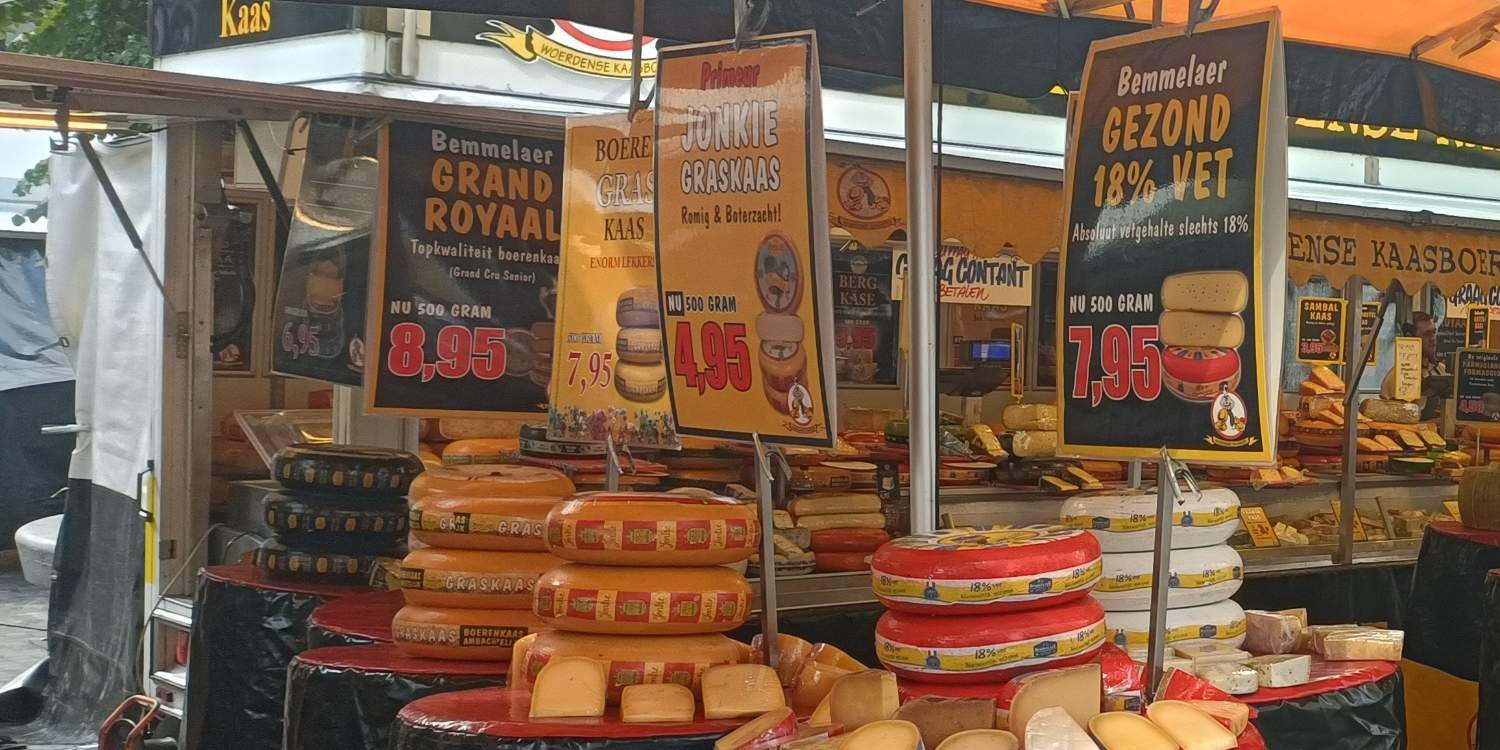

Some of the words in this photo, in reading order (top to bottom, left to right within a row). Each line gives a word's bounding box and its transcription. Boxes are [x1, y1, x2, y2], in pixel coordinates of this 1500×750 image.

[219, 0, 271, 37] Kaas
[541, 44, 610, 73] WOERDENSE
[701, 60, 760, 91] Primeur
[1117, 53, 1227, 97] Bemmelaer
[681, 99, 779, 152] JONKIE
[1102, 93, 1231, 153] GEZOND
[431, 129, 553, 165] Bemmelaer
[432, 158, 552, 203] GRAND
[681, 155, 781, 195] GRASKAAS
[1093, 159, 1156, 209] 18%
[1172, 148, 1233, 201] VET
[425, 197, 561, 241] ROYAAL
[604, 217, 644, 240] KAAS
[682, 206, 709, 229] Romig
[714, 206, 722, 223] &
[725, 203, 781, 224] Boterzacht!
[1072, 223, 1117, 242] Absoluut
[1119, 217, 1174, 243] vetgehalte
[1178, 216, 1218, 236] slechts
[1223, 214, 1249, 234] 18%
[410, 239, 492, 260] Topkwaliteit
[590, 257, 620, 269] ENORM
[449, 266, 480, 279] (Grand
[484, 268, 500, 280] Cru
[839, 275, 877, 290] BERG
[956, 257, 1029, 289] CONTANT
[390, 300, 411, 315] NU
[417, 302, 444, 316] 500
[451, 304, 492, 319] GRAM
[668, 294, 682, 312] NU
[686, 296, 704, 312] 500
[708, 295, 736, 312] GRAM
[1069, 294, 1085, 313] NU
[1090, 295, 1113, 313] 500
[1118, 293, 1153, 312] GRAM
[1304, 302, 1339, 312] SAMBAL
[1310, 312, 1333, 321] KAAS
[388, 322, 506, 382] 8,95
[674, 320, 752, 396] 4,95
[1068, 323, 1162, 408] 7,95
[569, 351, 612, 394] 7,95
[1130, 513, 1147, 523] 18%
[446, 575, 535, 592] GRASKAAS
[970, 581, 991, 593] 18%
[1116, 573, 1132, 582] 18%
[1202, 569, 1215, 578] 18%
[975, 648, 996, 660] 18%
